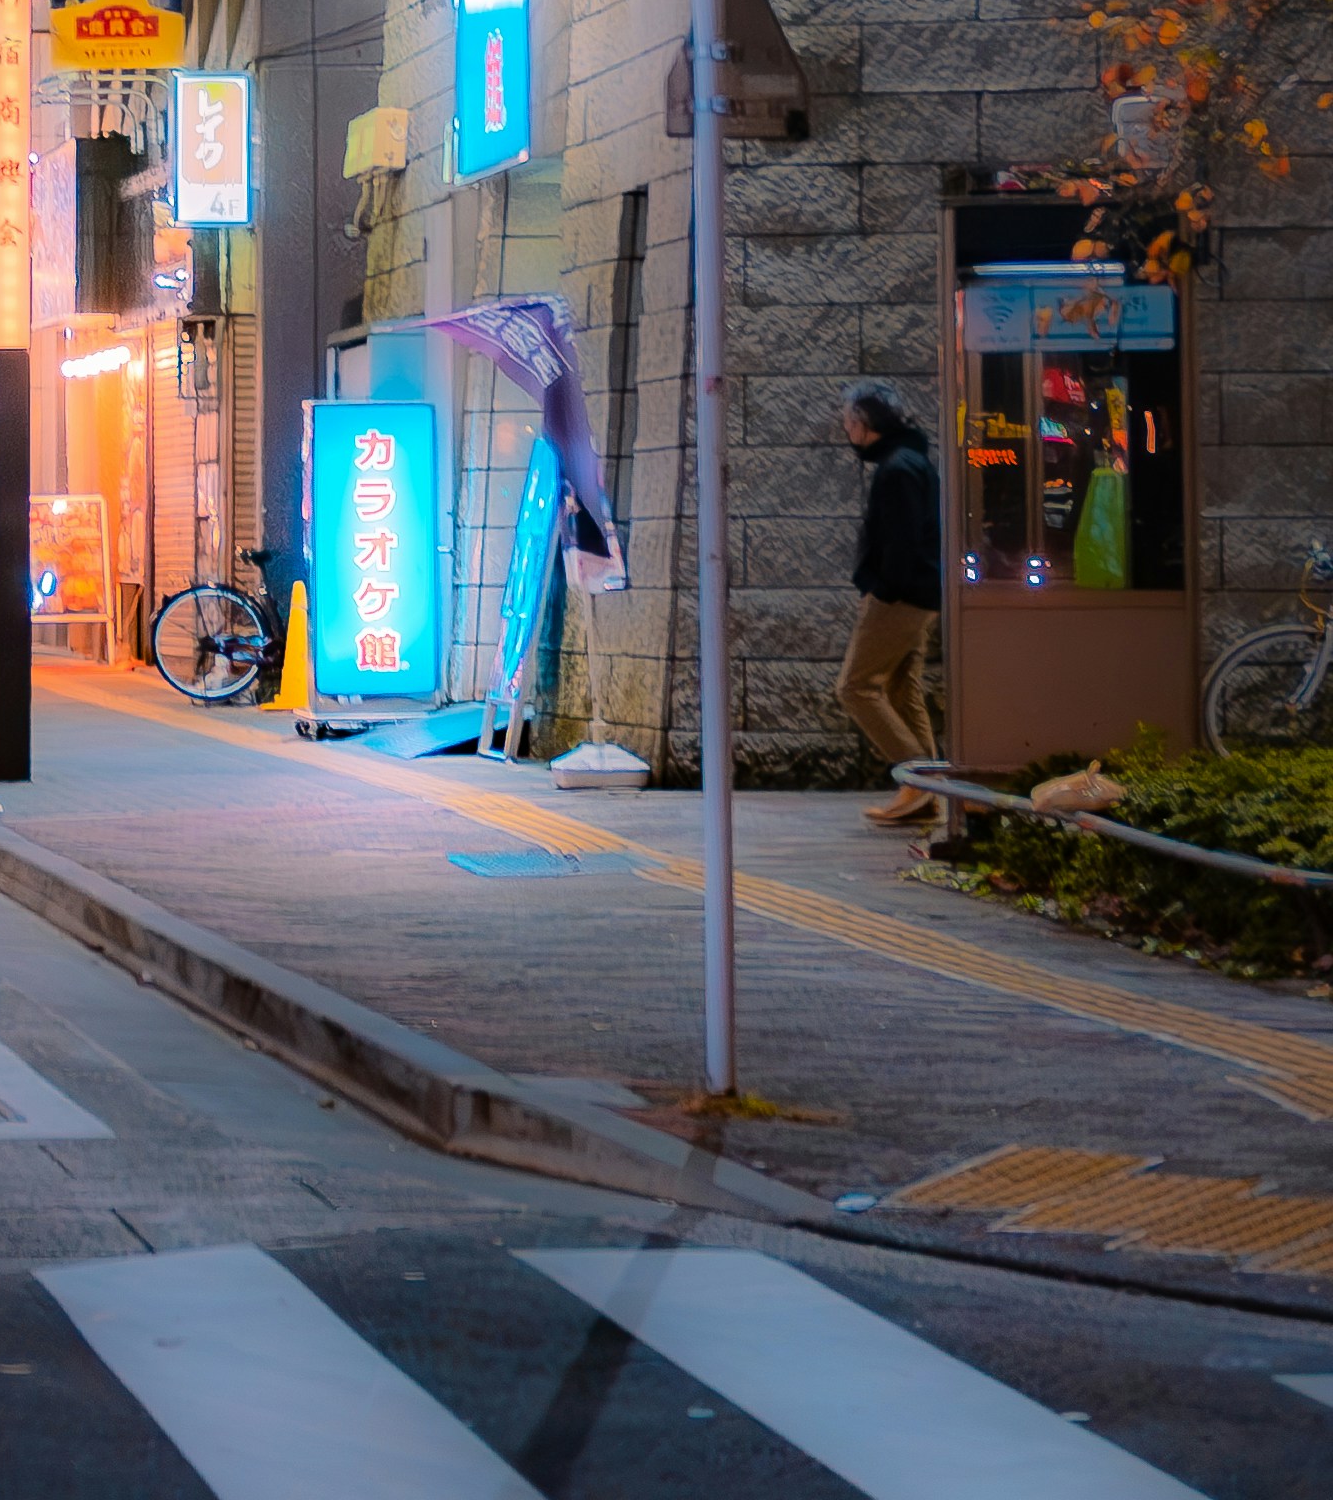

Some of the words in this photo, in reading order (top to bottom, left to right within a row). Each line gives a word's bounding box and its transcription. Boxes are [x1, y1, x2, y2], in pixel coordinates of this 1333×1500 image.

[195, 88, 225, 171] レイク
[353, 428, 400, 673] カラオケ館
